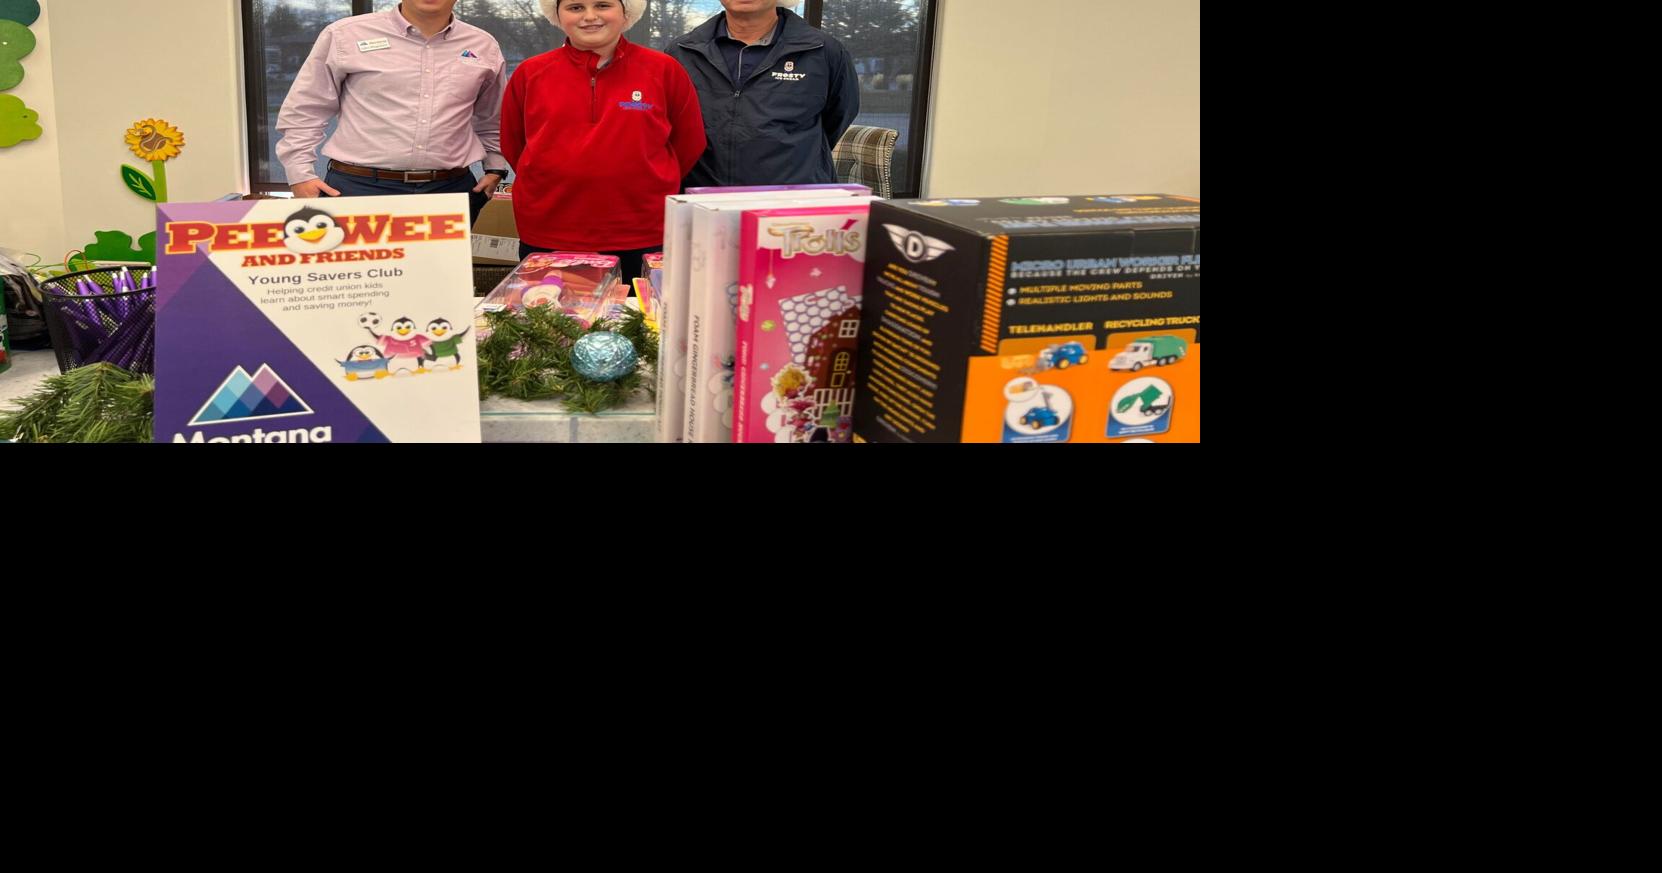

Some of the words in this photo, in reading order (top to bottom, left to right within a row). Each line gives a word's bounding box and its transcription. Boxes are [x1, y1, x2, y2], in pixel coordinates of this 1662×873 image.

[165, 221, 284, 255] PEE
[343, 213, 466, 243] WEE
[768, 219, 861, 260] Trolls
[241, 254, 297, 267] AND
[299, 248, 405, 265] FRIENDS
[248, 275, 301, 286] Young
[307, 270, 362, 282] Savers
[367, 267, 403, 279] Club
[1124, 264, 1174, 274] DEPENDS
[267, 287, 304, 296] Helping
[306, 284, 333, 293] credit
[335, 283, 363, 291] union
[364, 282, 384, 290] kids
[1019, 285, 1067, 294] MULTIPLE
[1069, 283, 1111, 292] MOVING
[1112, 281, 1143, 290] PARTS
[260, 296, 285, 304] learn
[287, 295, 315, 303] about
[317, 293, 345, 301] smart
[347, 289, 390, 299] spending
[1018, 296, 1072, 305] REALISTIC
[1073, 293, 1109, 303] LIGHTS
[1110, 293, 1132, 301] AND
[1133, 290, 1174, 299] SOUNDS
[282, 304, 301, 312] and
[303, 302, 335, 311] saving
[337, 299, 373, 308] money!
[692, 315, 700, 339] FOAM
[1007, 322, 1093, 335] TELEHANDLER
[1104, 317, 1166, 329] RECYCLING
[1166, 316, 1201, 326] TRUCK
[689, 343, 699, 408] GINGERBREAD
[687, 408, 696, 438] HOUSE
